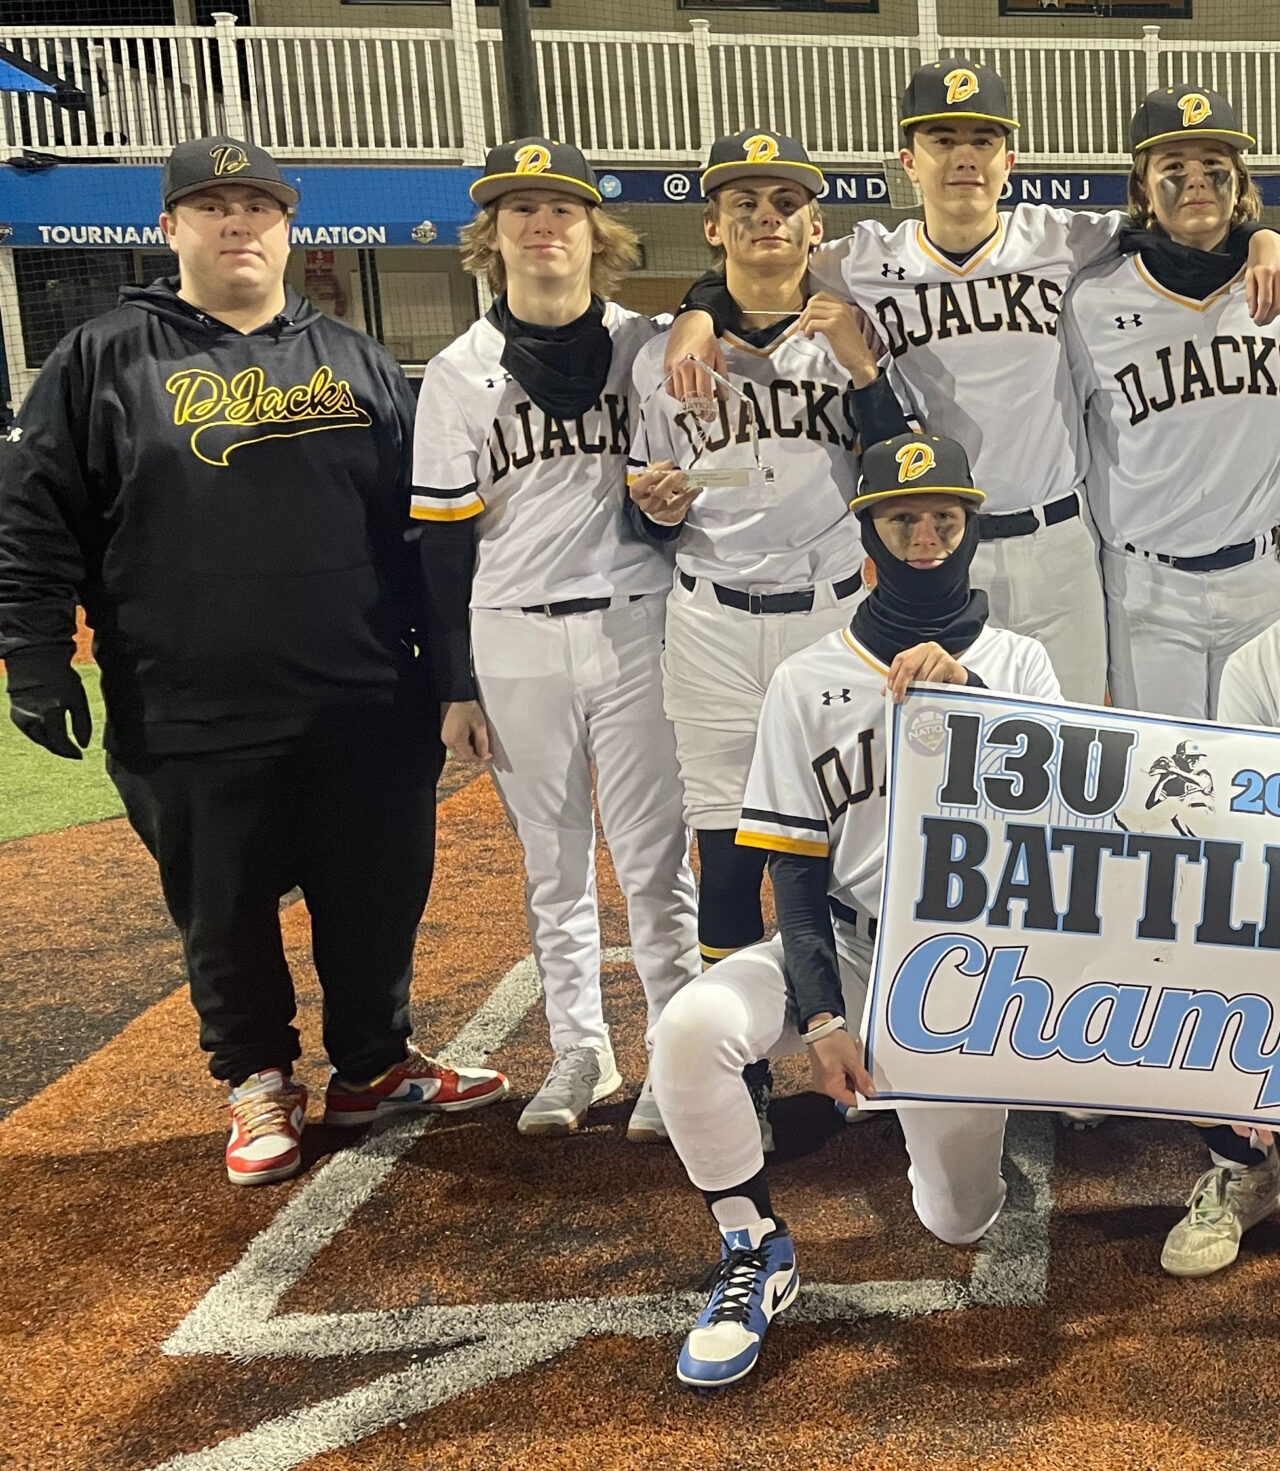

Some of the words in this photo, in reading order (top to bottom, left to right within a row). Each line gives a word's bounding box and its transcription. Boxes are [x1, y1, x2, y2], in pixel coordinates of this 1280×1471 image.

[38, 225, 168, 245] TOURNAM
[291, 226, 387, 244] MATION
[876, 274, 1061, 357] DJACKS
[487, 394, 630, 484] DJACK
[908, 725, 944, 741] NATIO
[938, 712, 1137, 816] 13U
